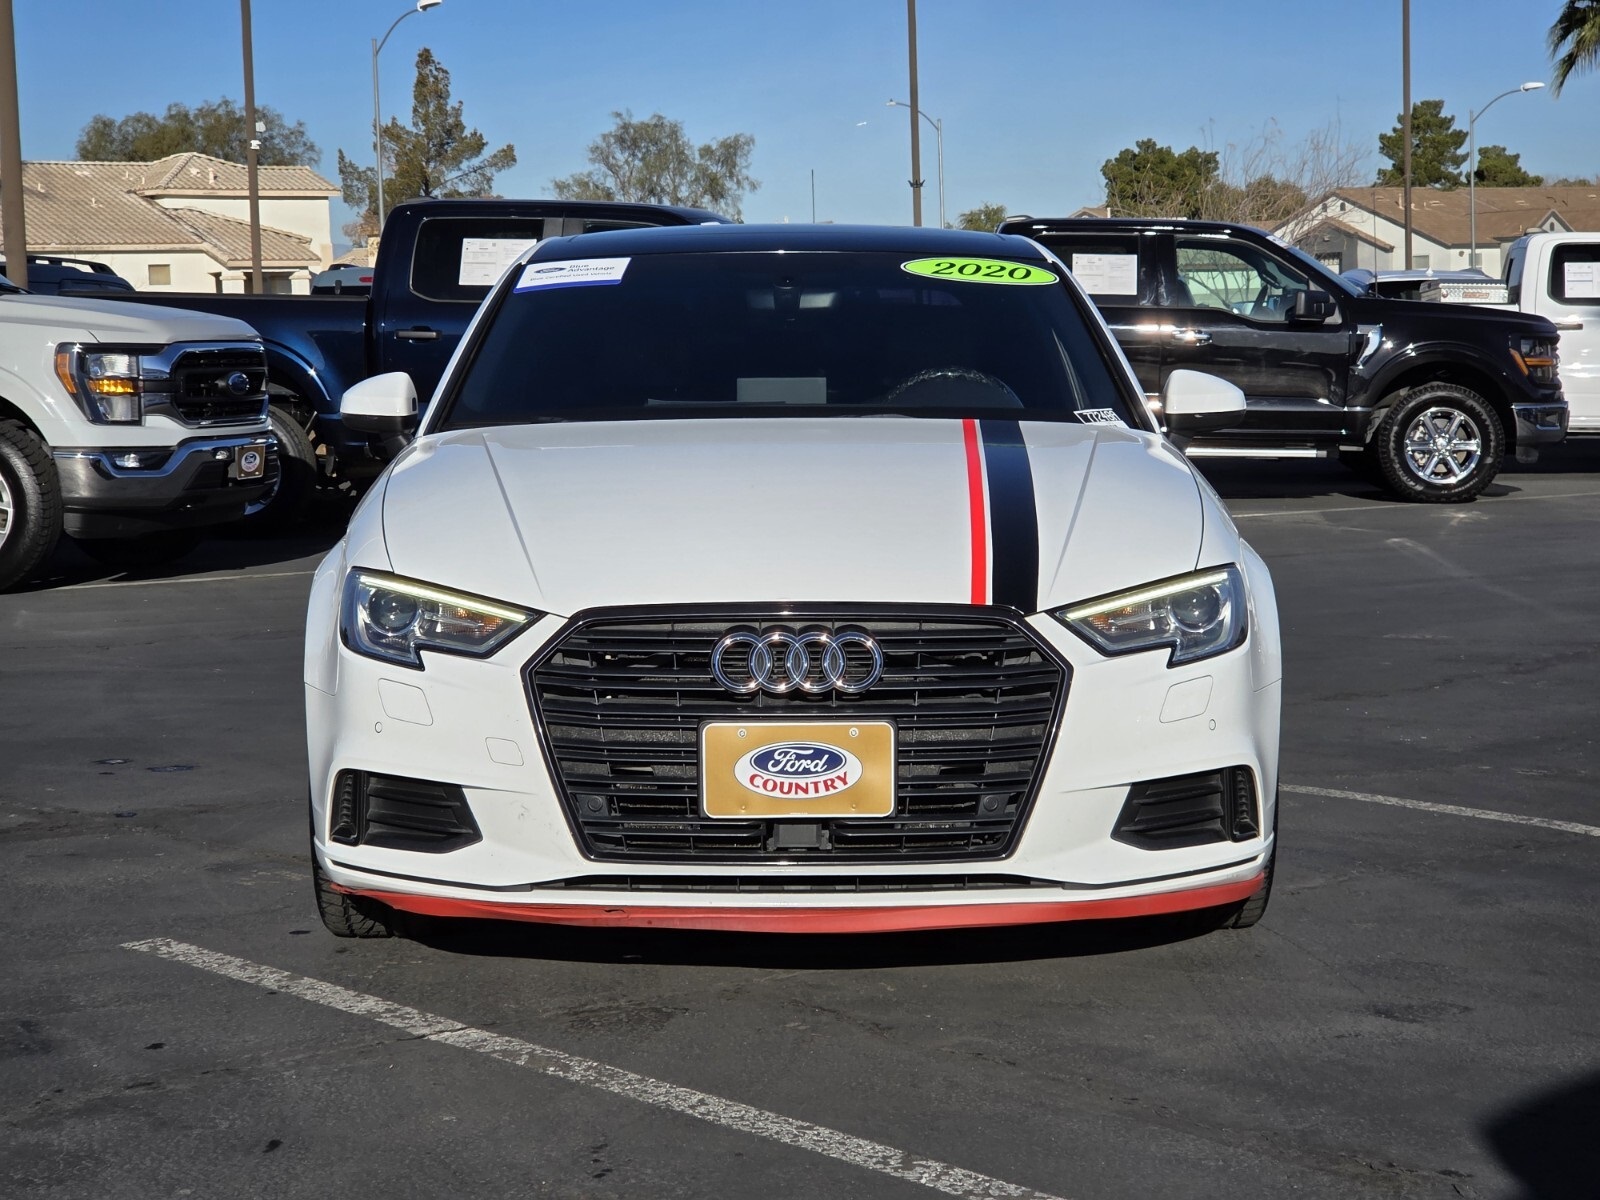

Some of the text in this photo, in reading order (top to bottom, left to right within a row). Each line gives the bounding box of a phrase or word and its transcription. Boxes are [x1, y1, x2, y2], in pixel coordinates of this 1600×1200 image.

[930, 261, 1032, 280] 2020
[767, 748, 829, 772] Ford
[749, 771, 848, 795] COUNTRY
